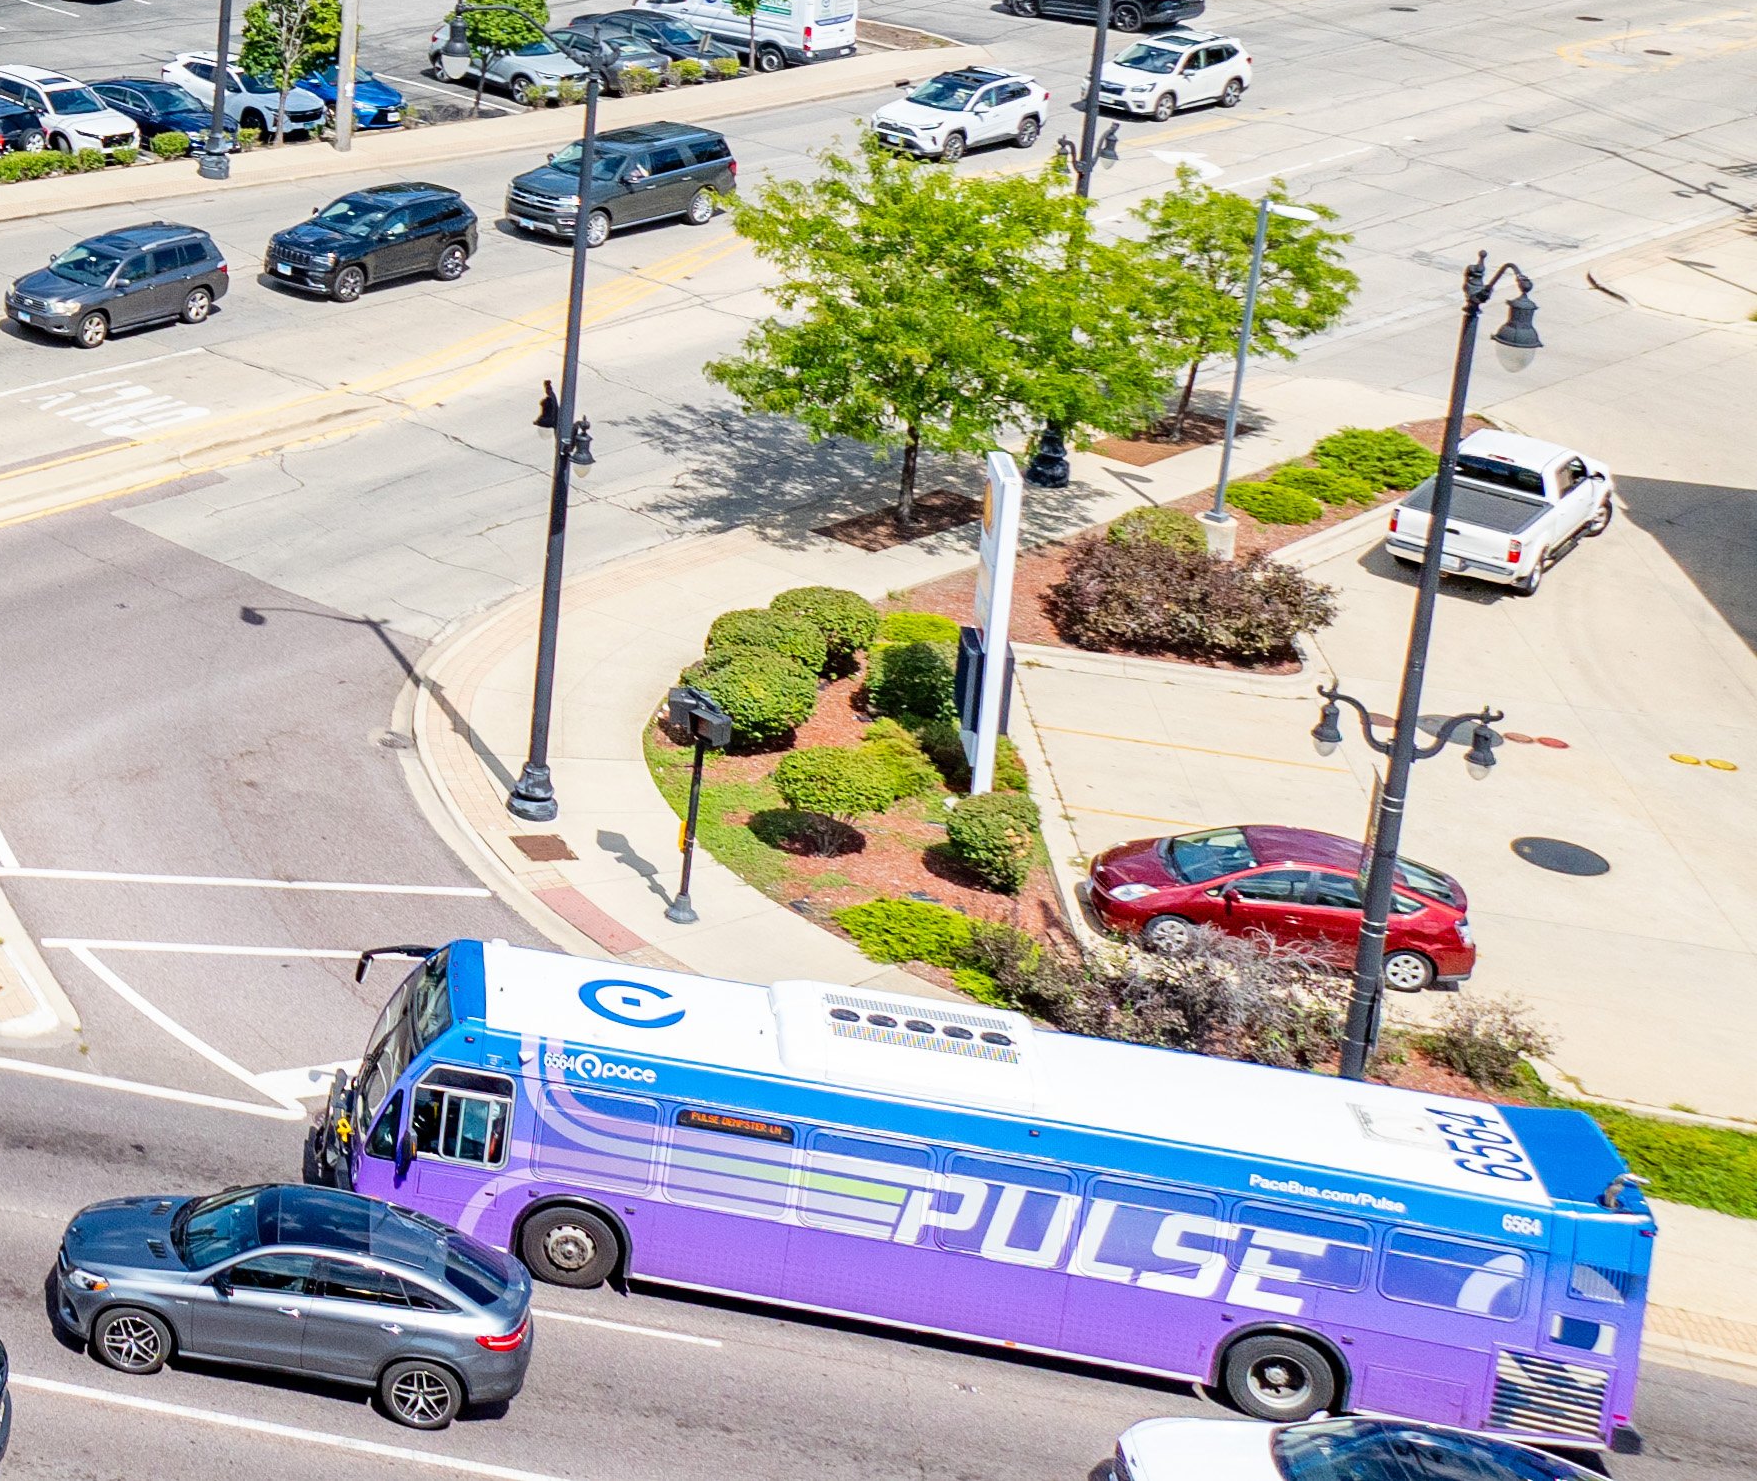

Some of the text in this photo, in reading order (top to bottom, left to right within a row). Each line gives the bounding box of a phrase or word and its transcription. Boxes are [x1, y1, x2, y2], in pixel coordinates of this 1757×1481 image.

[543, 1051, 658, 1084] 6564 pace
[691, 1110, 719, 1125] PULSE
[721, 1116, 767, 1132] DEMPSTER
[1423, 1107, 1533, 1182] 6564
[1248, 1173, 1408, 1213] PaceBus.com/Pulse
[1501, 1214, 1543, 1237] 6564
[894, 1172, 1330, 1316] PULSE
